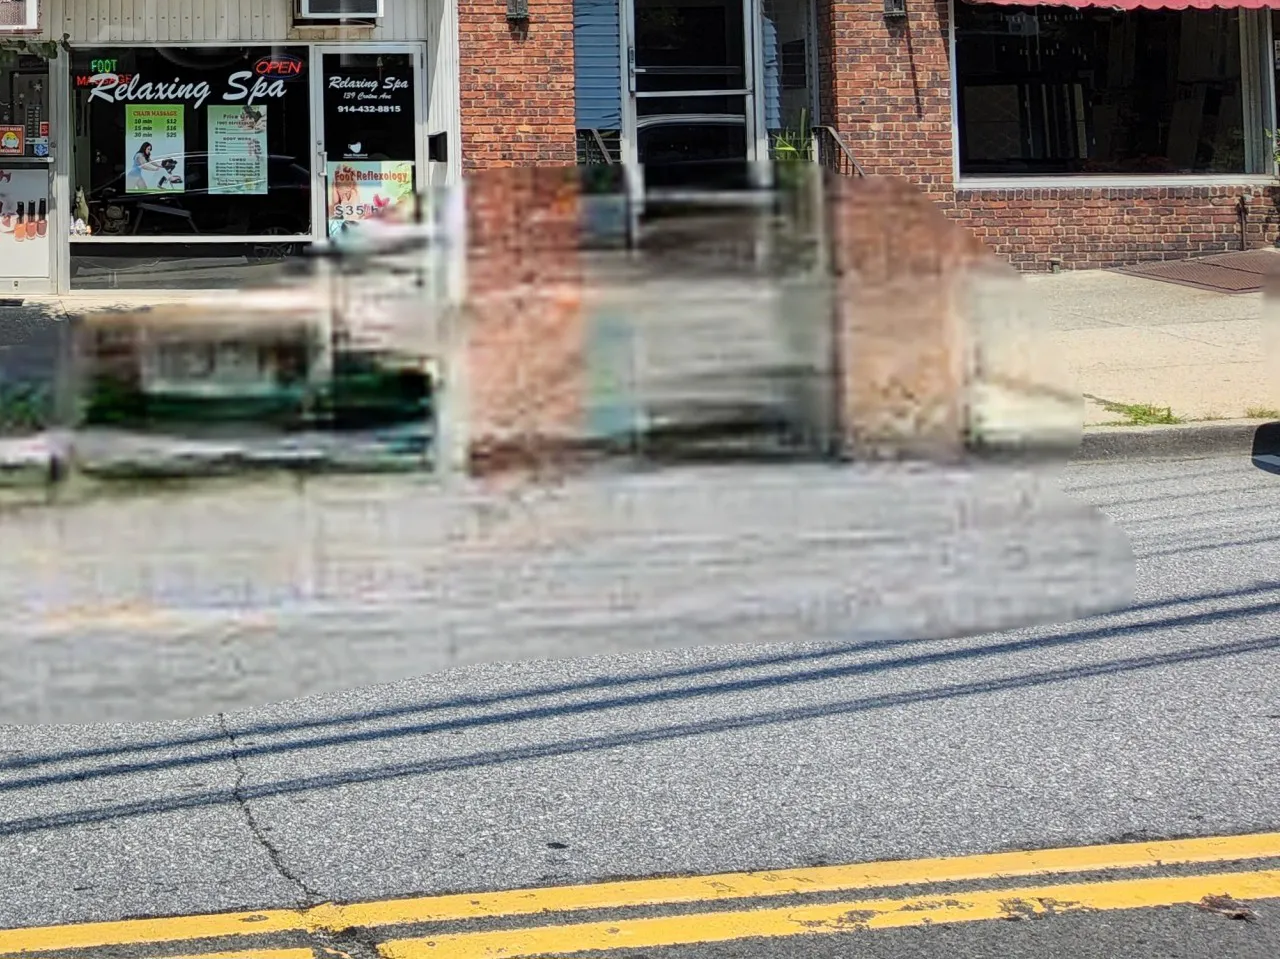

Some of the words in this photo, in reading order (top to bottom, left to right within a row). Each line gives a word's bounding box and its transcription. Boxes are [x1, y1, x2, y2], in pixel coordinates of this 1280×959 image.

[91, 59, 118, 73] FOOT
[255, 59, 303, 74] OPEN
[88, 73, 211, 109] Relaxing
[222, 71, 287, 105] Spa
[328, 76, 379, 92] Relaxing
[382, 76, 409, 91] Spa
[343, 91, 356, 99] 139
[334, 170, 354, 181] Foot
[356, 170, 408, 183] Reflexology
[335, 204, 364, 216] $35
